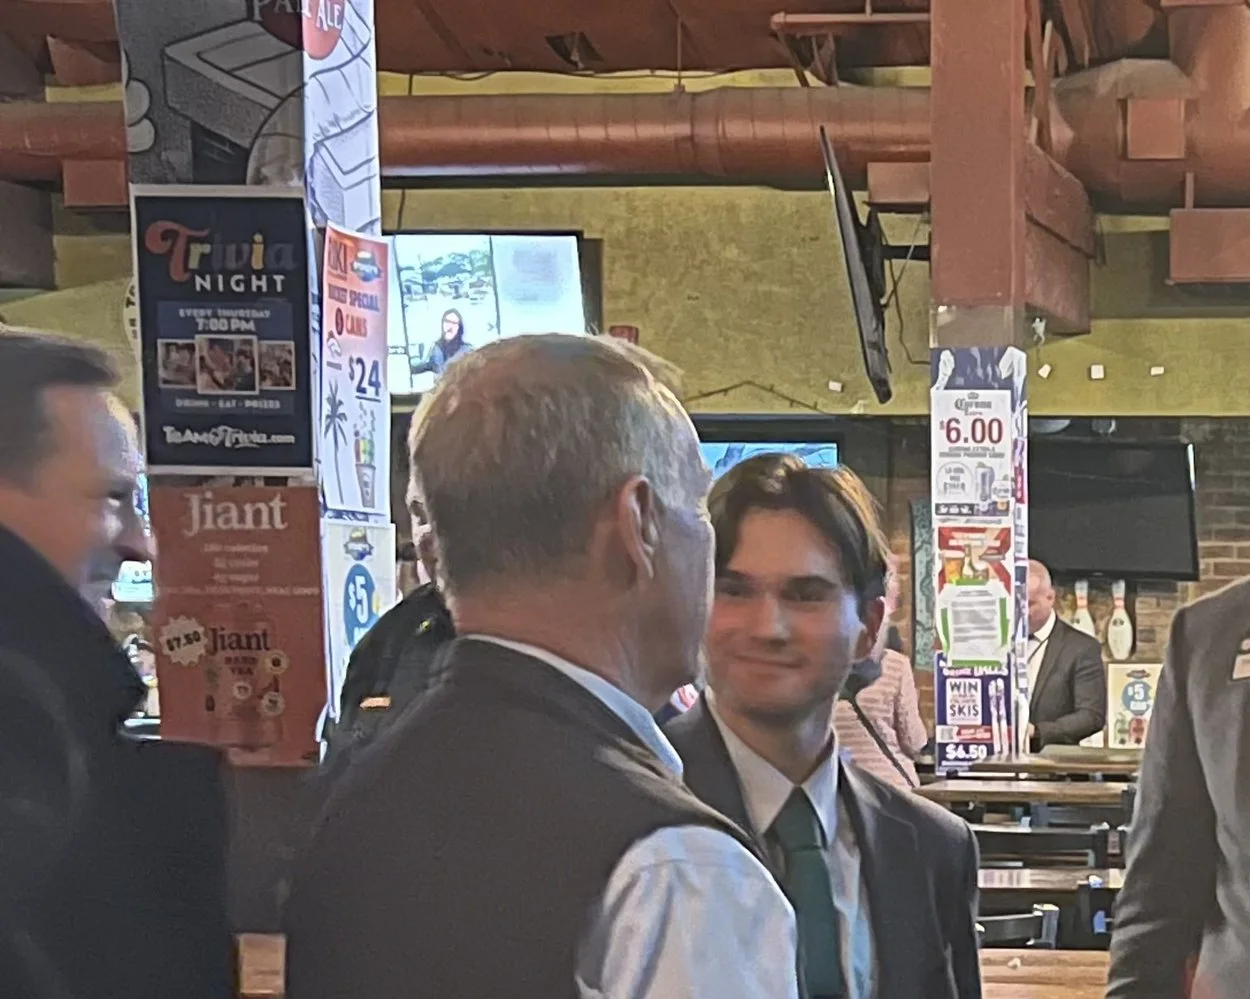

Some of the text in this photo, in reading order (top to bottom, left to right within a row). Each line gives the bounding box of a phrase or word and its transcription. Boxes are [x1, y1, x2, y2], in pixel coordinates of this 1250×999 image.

[145, 220, 297, 282] Trivia
[194, 274, 286, 293] NIGHT
[350, 289, 379, 312] SPECIAL
[217, 308, 271, 318] THURSDAY
[196, 318, 256, 332] 7:00 PM
[349, 355, 381, 396] $24
[940, 417, 1003, 444] $6.00
[184, 491, 288, 537] Jiant
[347, 575, 369, 624] $5
[166, 630, 201, 652] $7.50
[208, 627, 270, 656] Jiant
[949, 681, 978, 693] WIN
[949, 704, 979, 718] SKIS
[945, 743, 988, 760] $6.50
